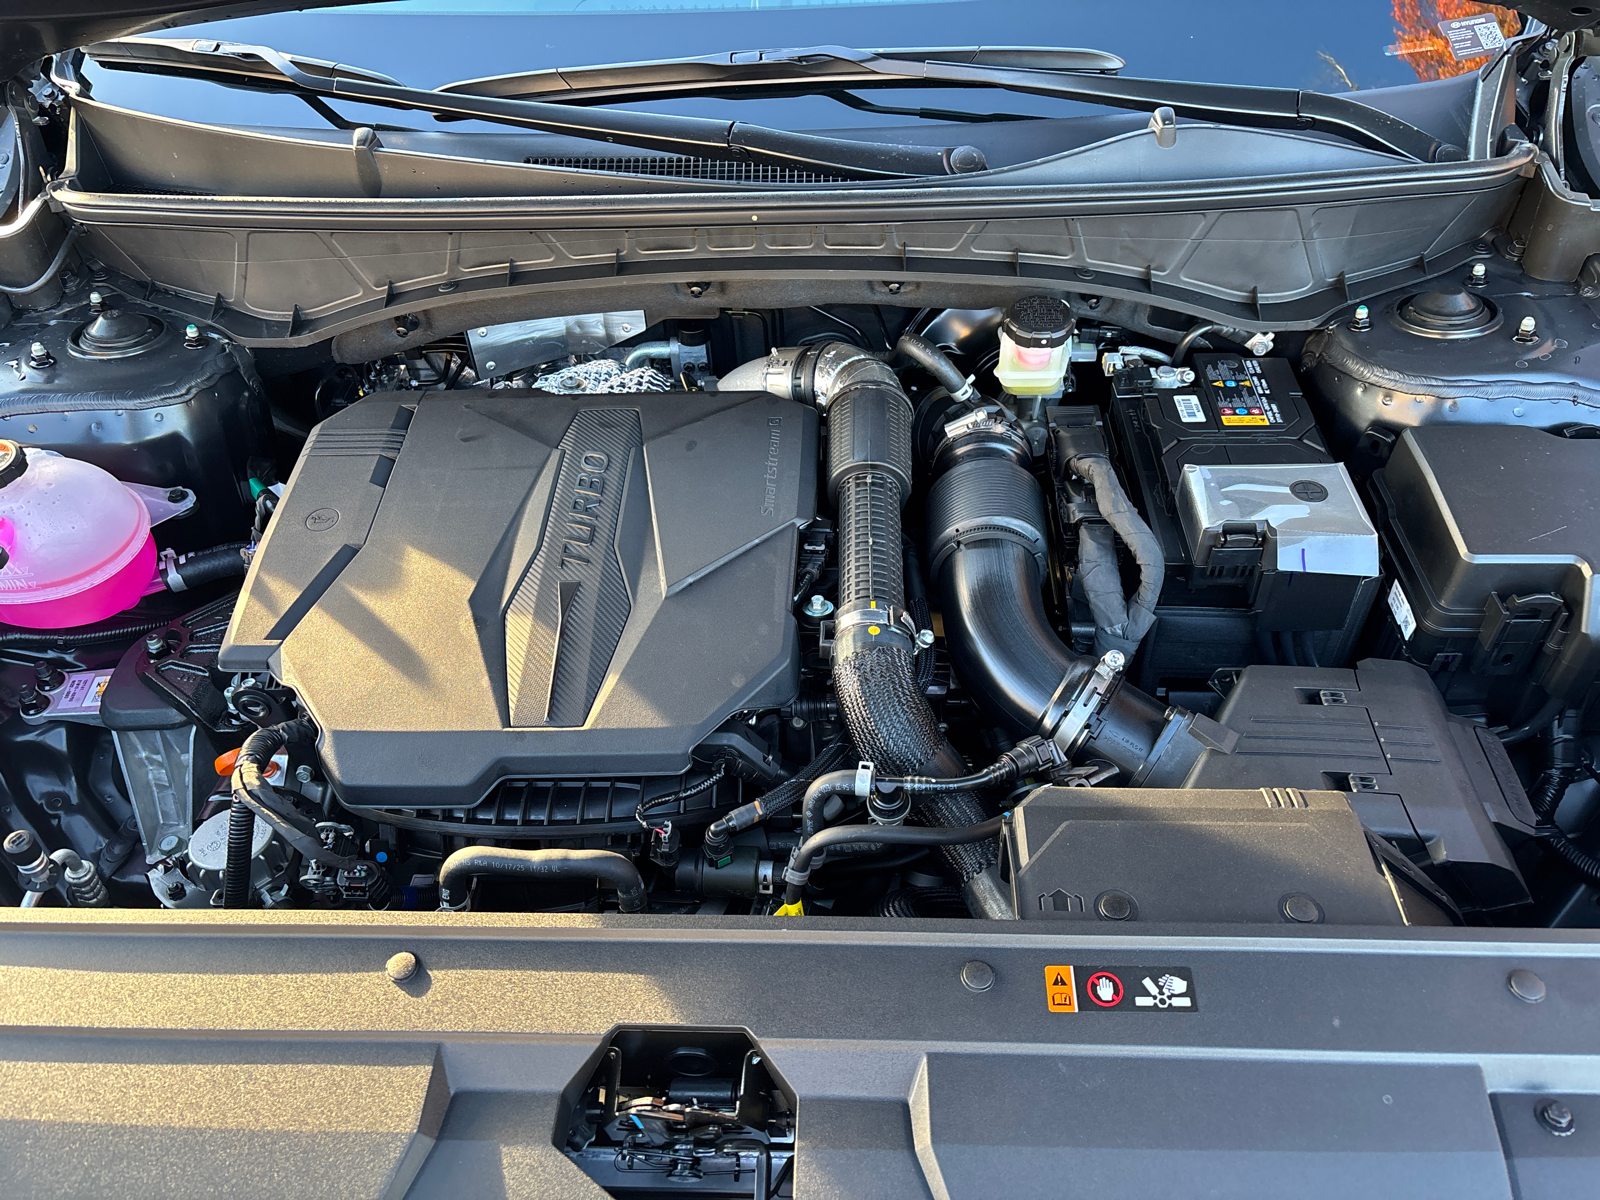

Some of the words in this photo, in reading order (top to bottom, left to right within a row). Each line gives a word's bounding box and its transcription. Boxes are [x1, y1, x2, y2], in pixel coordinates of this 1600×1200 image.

[1461, 18, 1486, 26] HYUNDAI
[557, 449, 610, 570] TURBO
[760, 428, 782, 517] Smartstream
